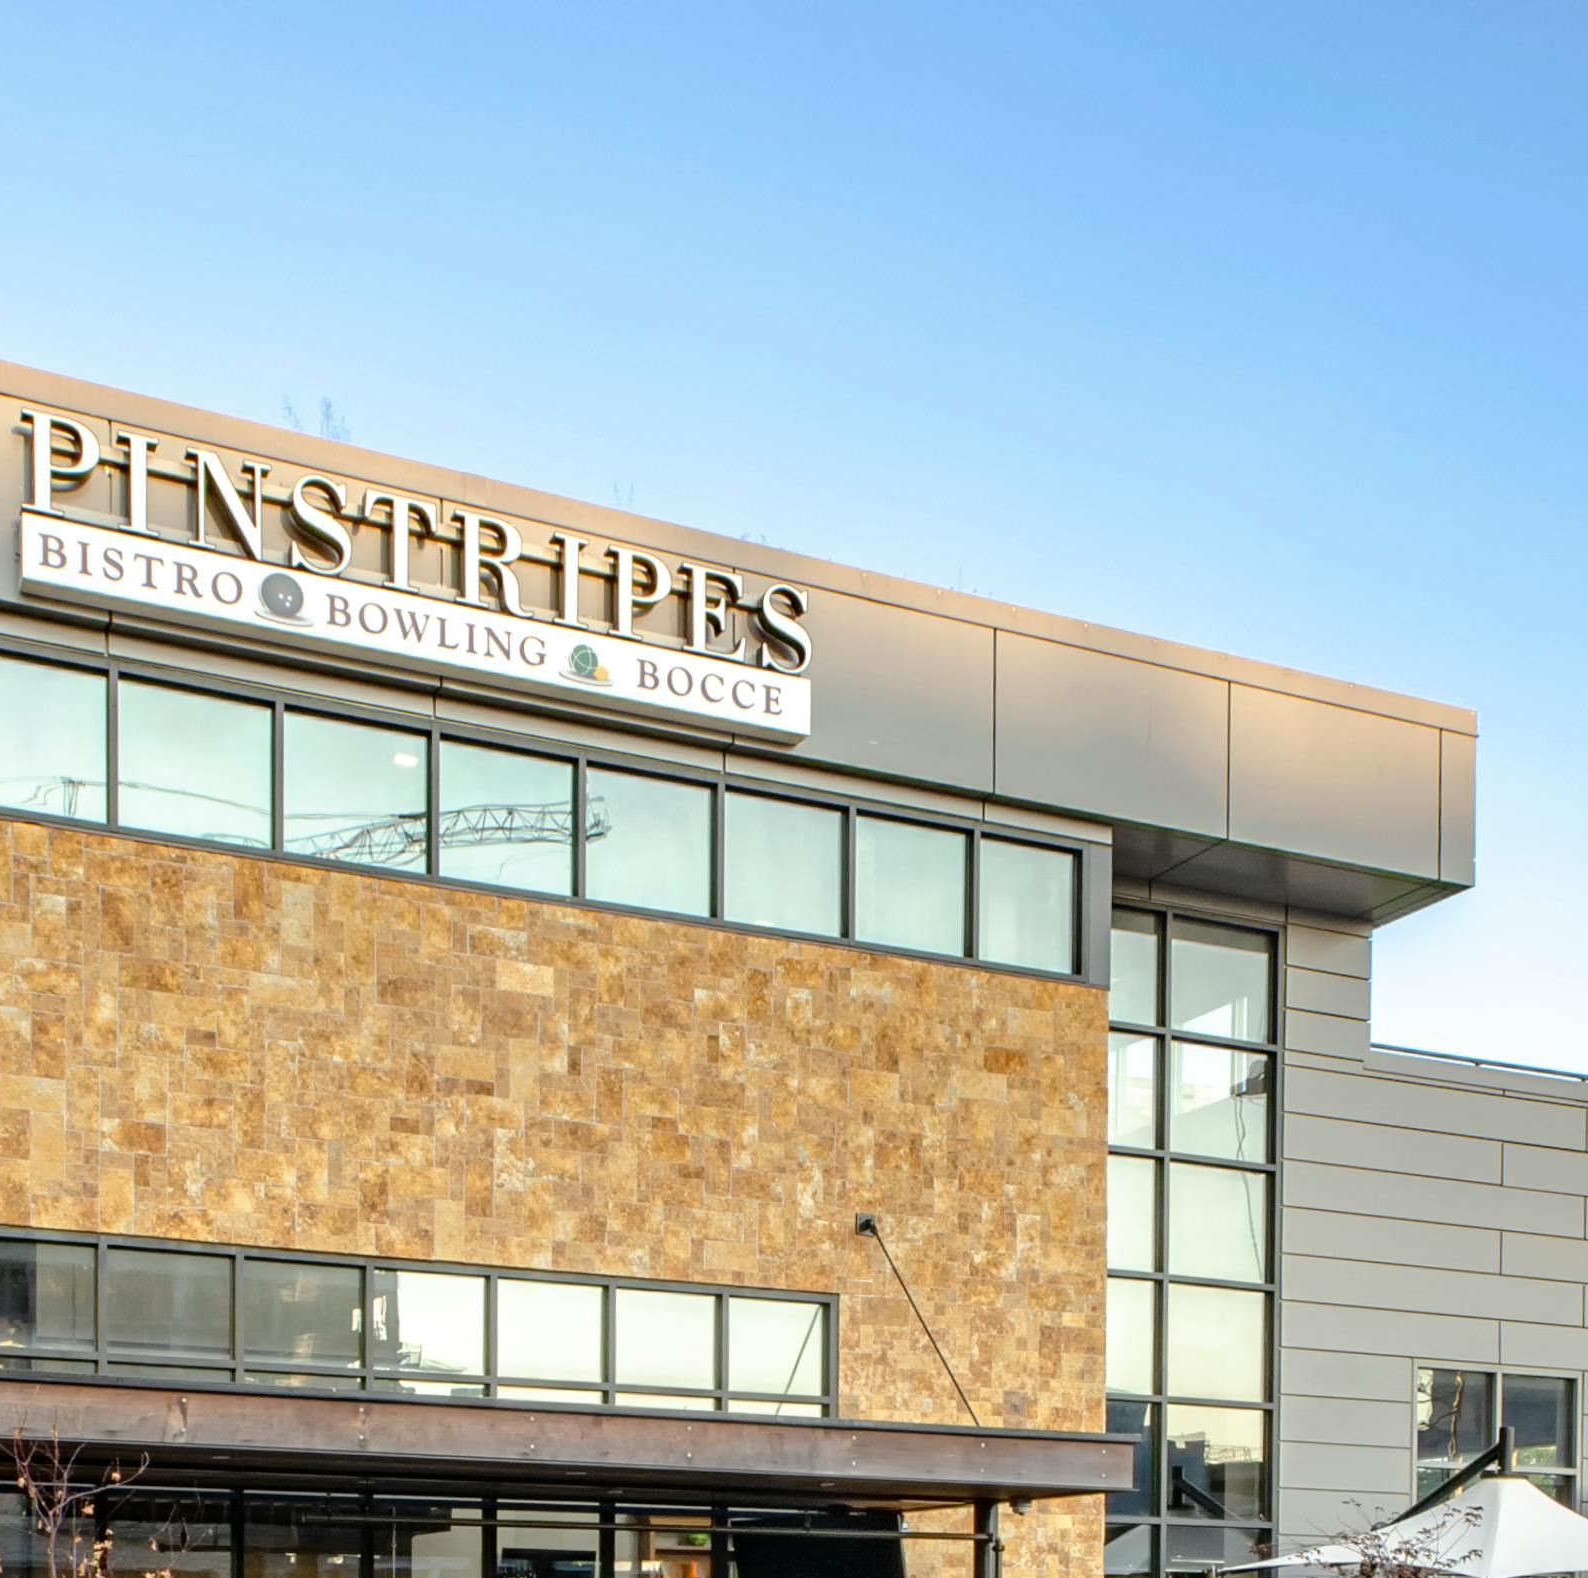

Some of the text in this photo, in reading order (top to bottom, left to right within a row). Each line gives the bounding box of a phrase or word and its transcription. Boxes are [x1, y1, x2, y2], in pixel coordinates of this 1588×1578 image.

[20, 409, 812, 676] PINSTRIPES
[38, 532, 785, 716] BISTRO BOWLING BOCCE
